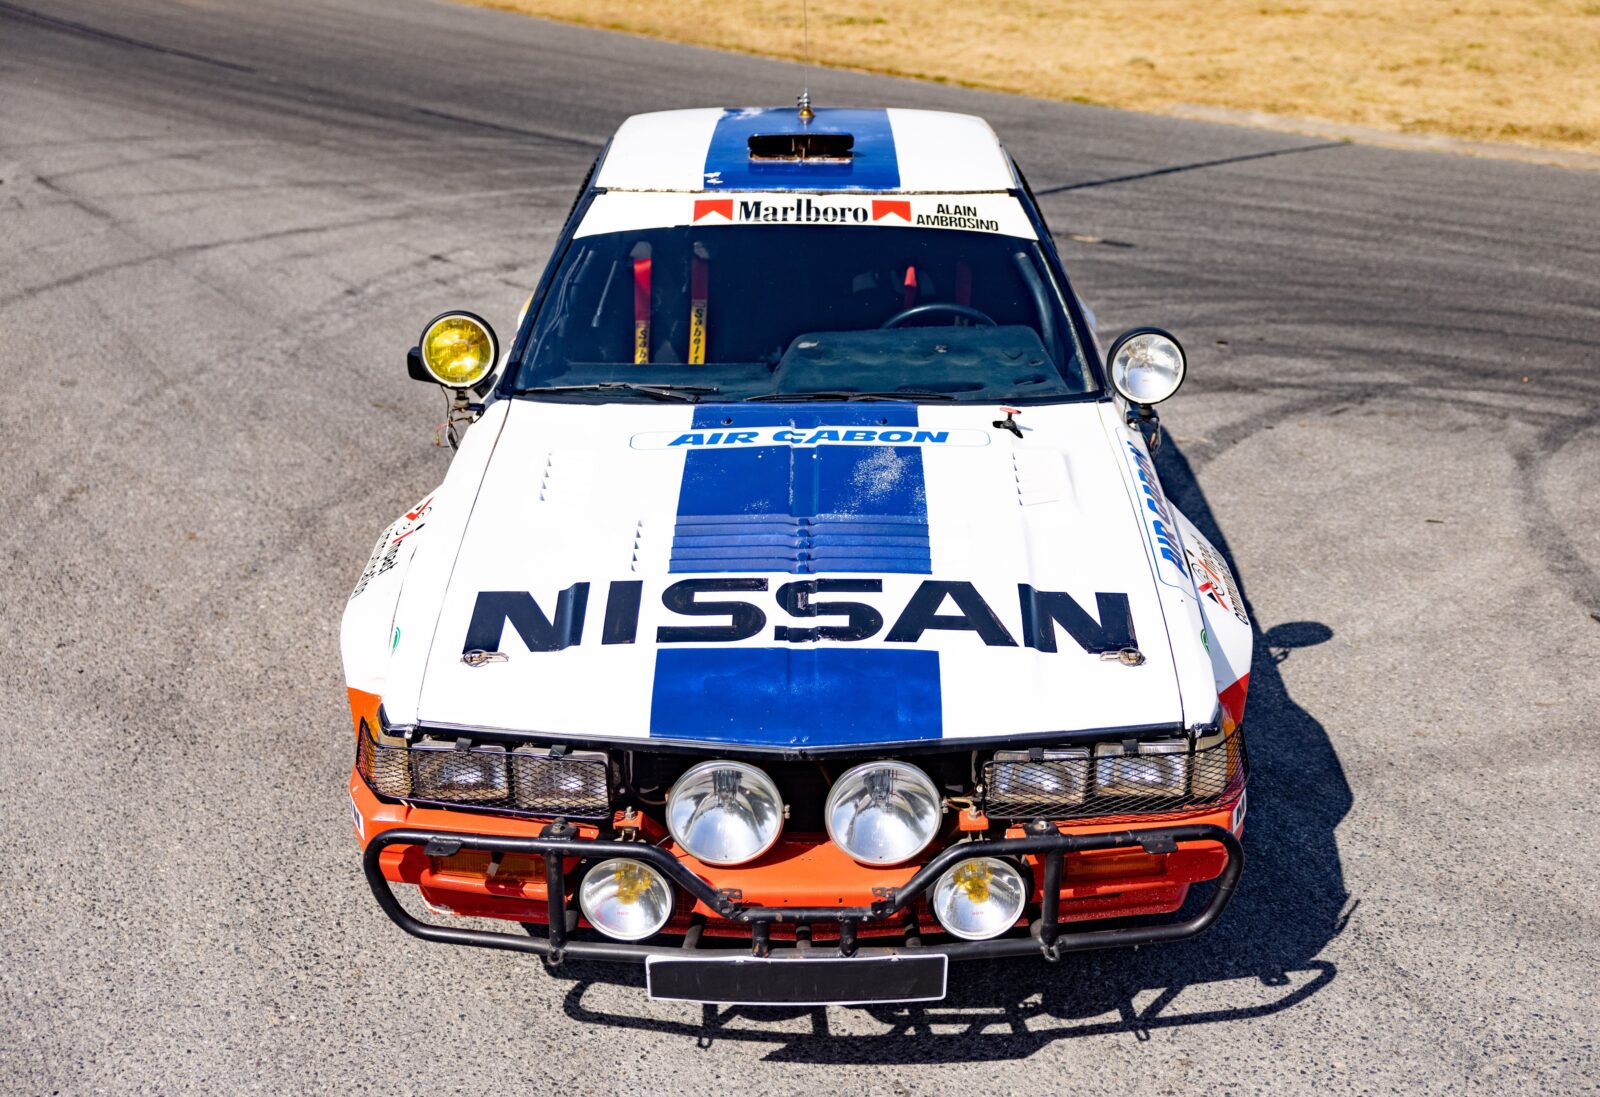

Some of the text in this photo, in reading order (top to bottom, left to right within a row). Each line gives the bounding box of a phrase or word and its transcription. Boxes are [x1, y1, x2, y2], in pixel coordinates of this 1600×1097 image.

[738, 198, 868, 223] Marlboro
[936, 203, 978, 217] ALAIN
[916, 214, 999, 232] AMBROSINO
[667, 430, 949, 447] AIR GABON
[462, 578, 1139, 654] NISSAN
